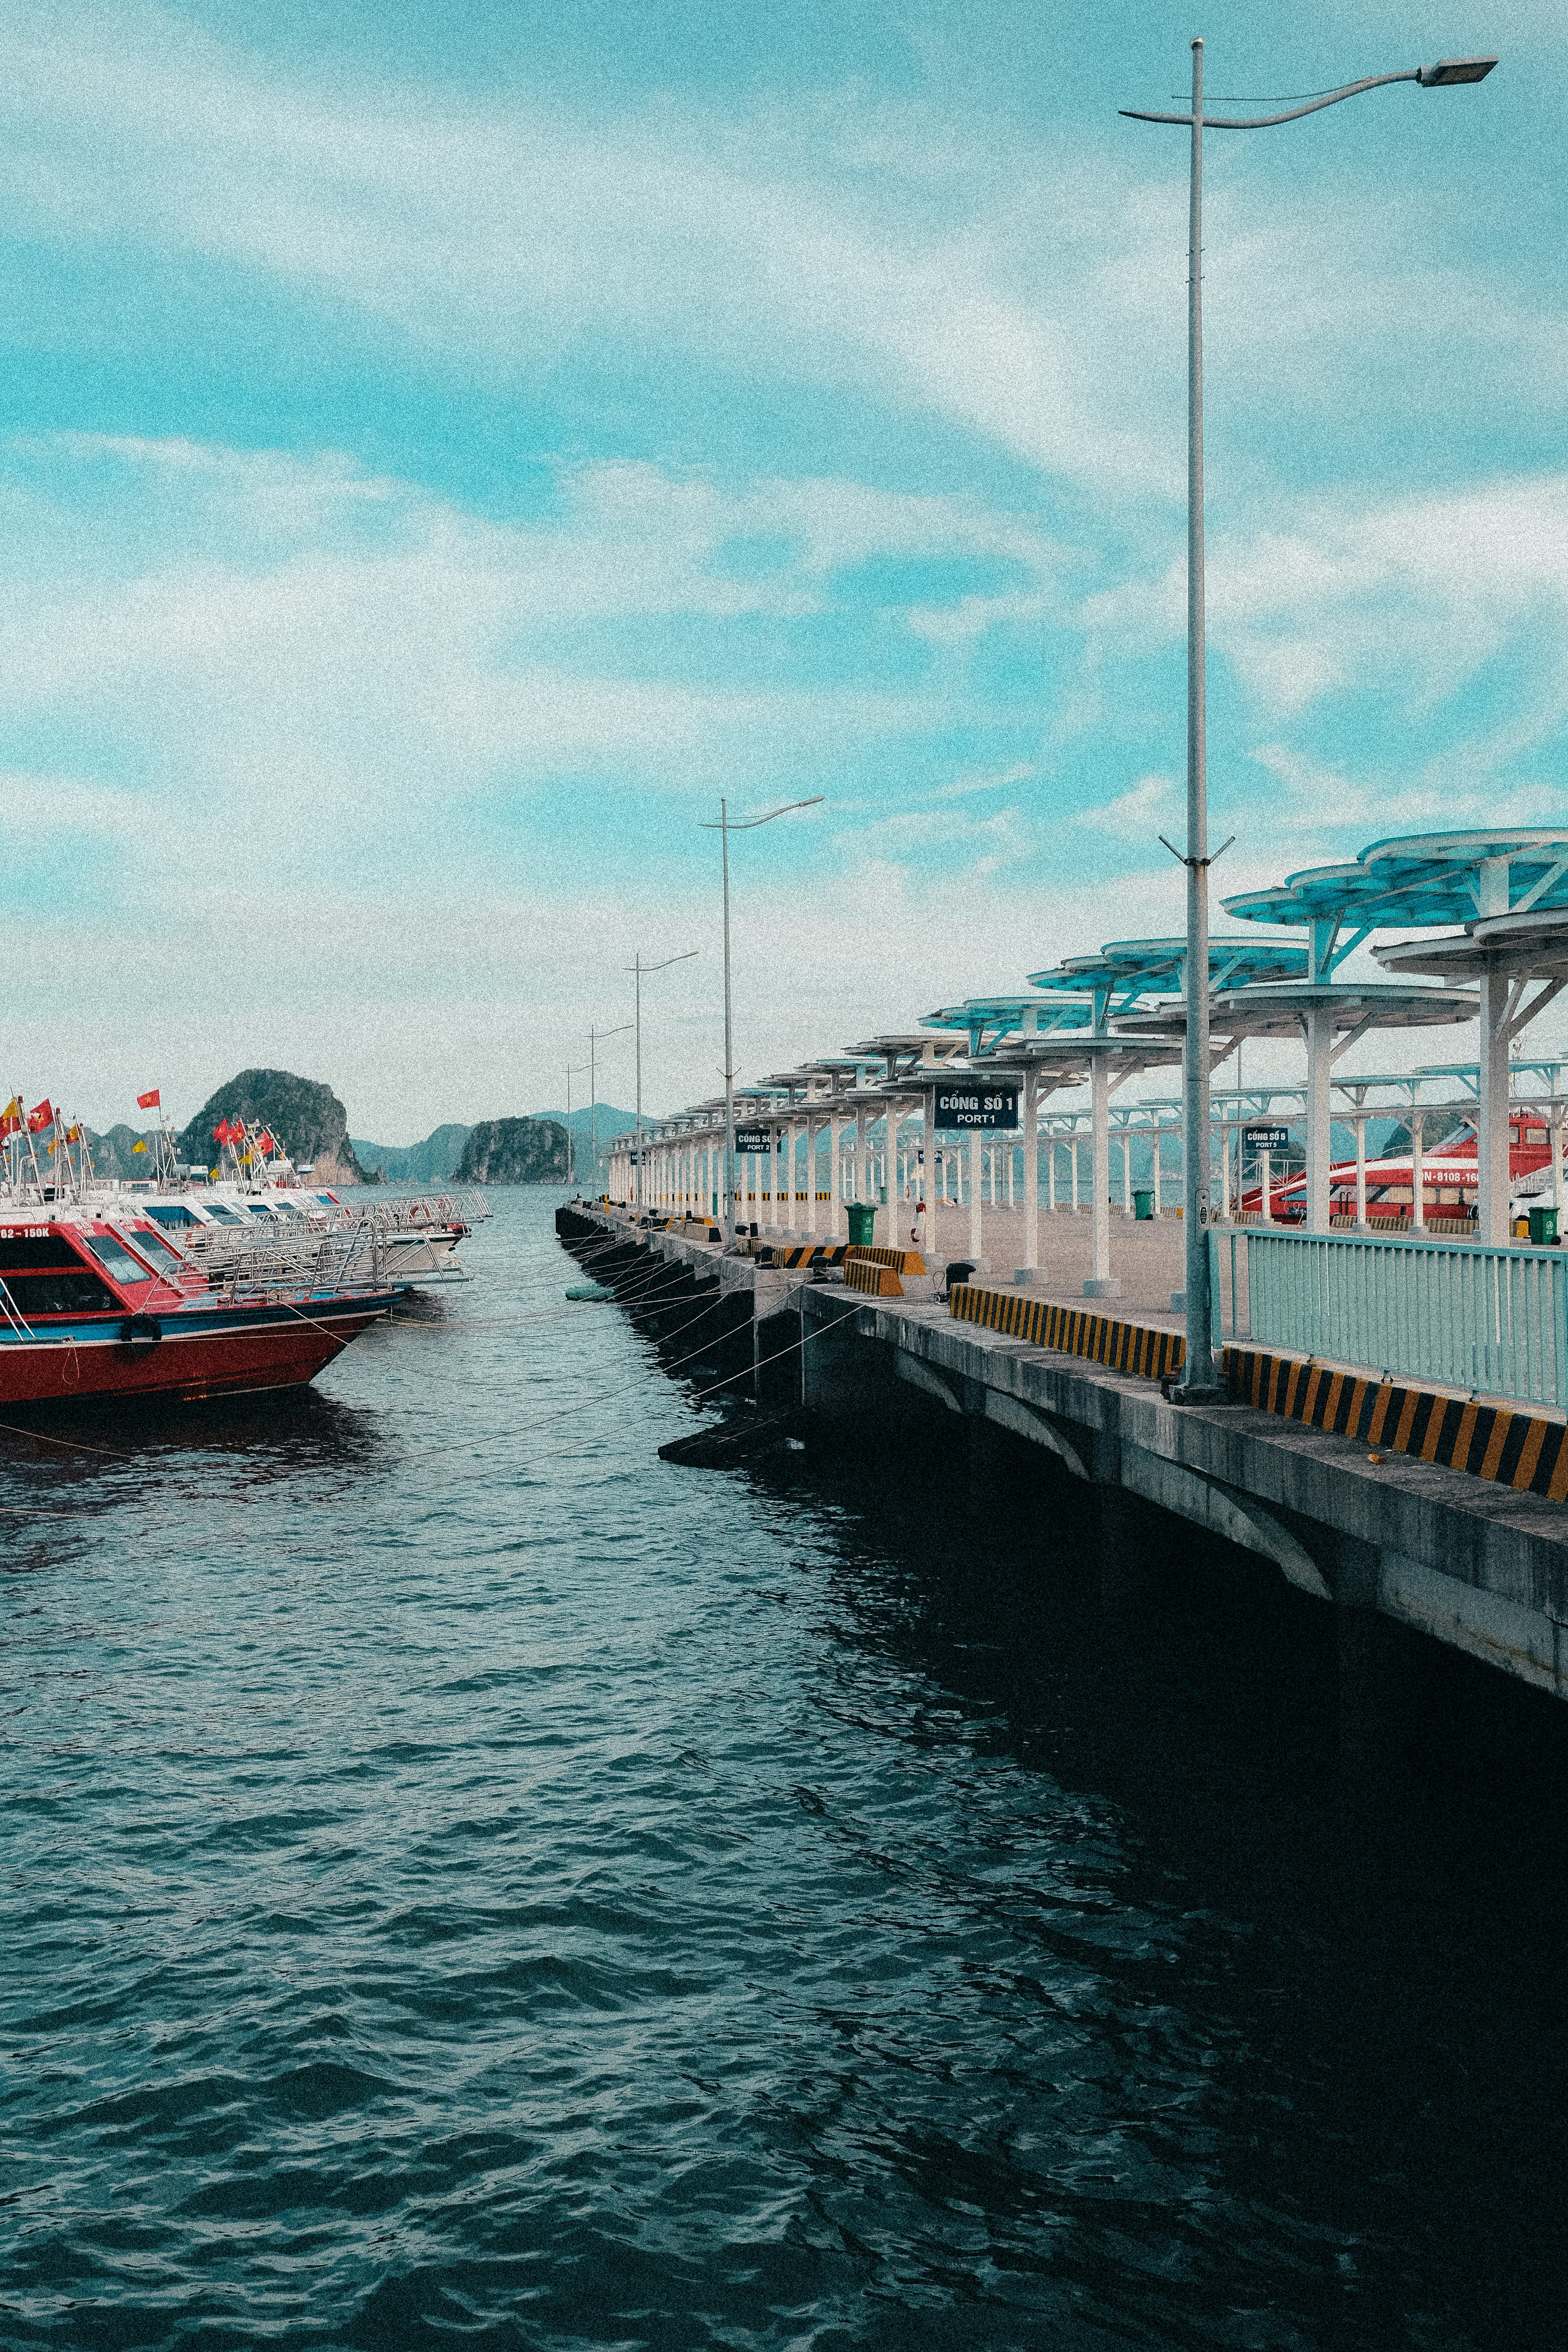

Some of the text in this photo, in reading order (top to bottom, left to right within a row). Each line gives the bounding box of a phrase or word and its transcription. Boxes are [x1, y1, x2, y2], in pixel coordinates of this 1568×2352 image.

[940, 1090, 1012, 1110] CỔNG SỐ 1
[957, 1115, 995, 1123] PORT 1
[1269, 1130, 1280, 1141] SỐ
[1423, 1171, 1479, 1182] N-8108-16
